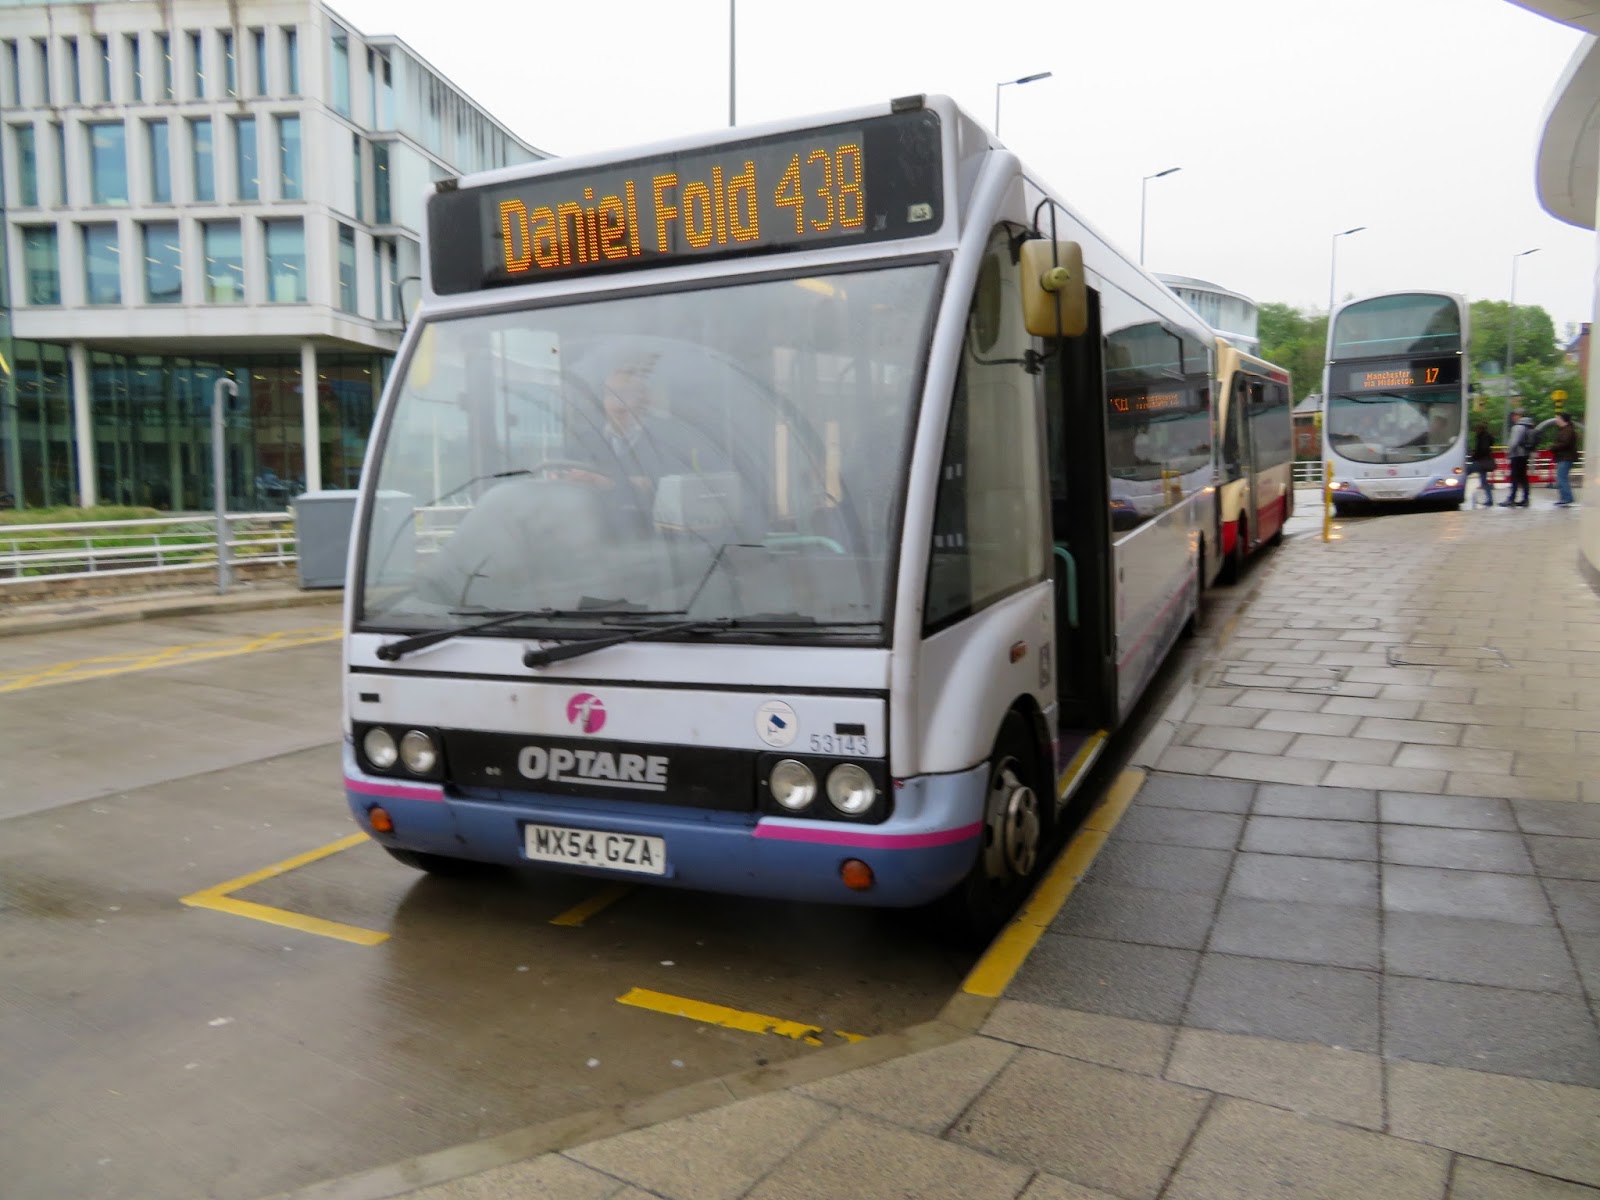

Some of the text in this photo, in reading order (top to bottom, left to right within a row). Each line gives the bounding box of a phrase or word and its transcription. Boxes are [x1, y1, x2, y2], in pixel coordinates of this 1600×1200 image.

[500, 143, 864, 274] Daniel Fold 438
[1366, 371, 1411, 380] Manchester
[1426, 367, 1440, 384] 17
[810, 733, 869, 755] 53143
[518, 746, 670, 784] OPTARE
[535, 828, 654, 867] MX54 GZA
